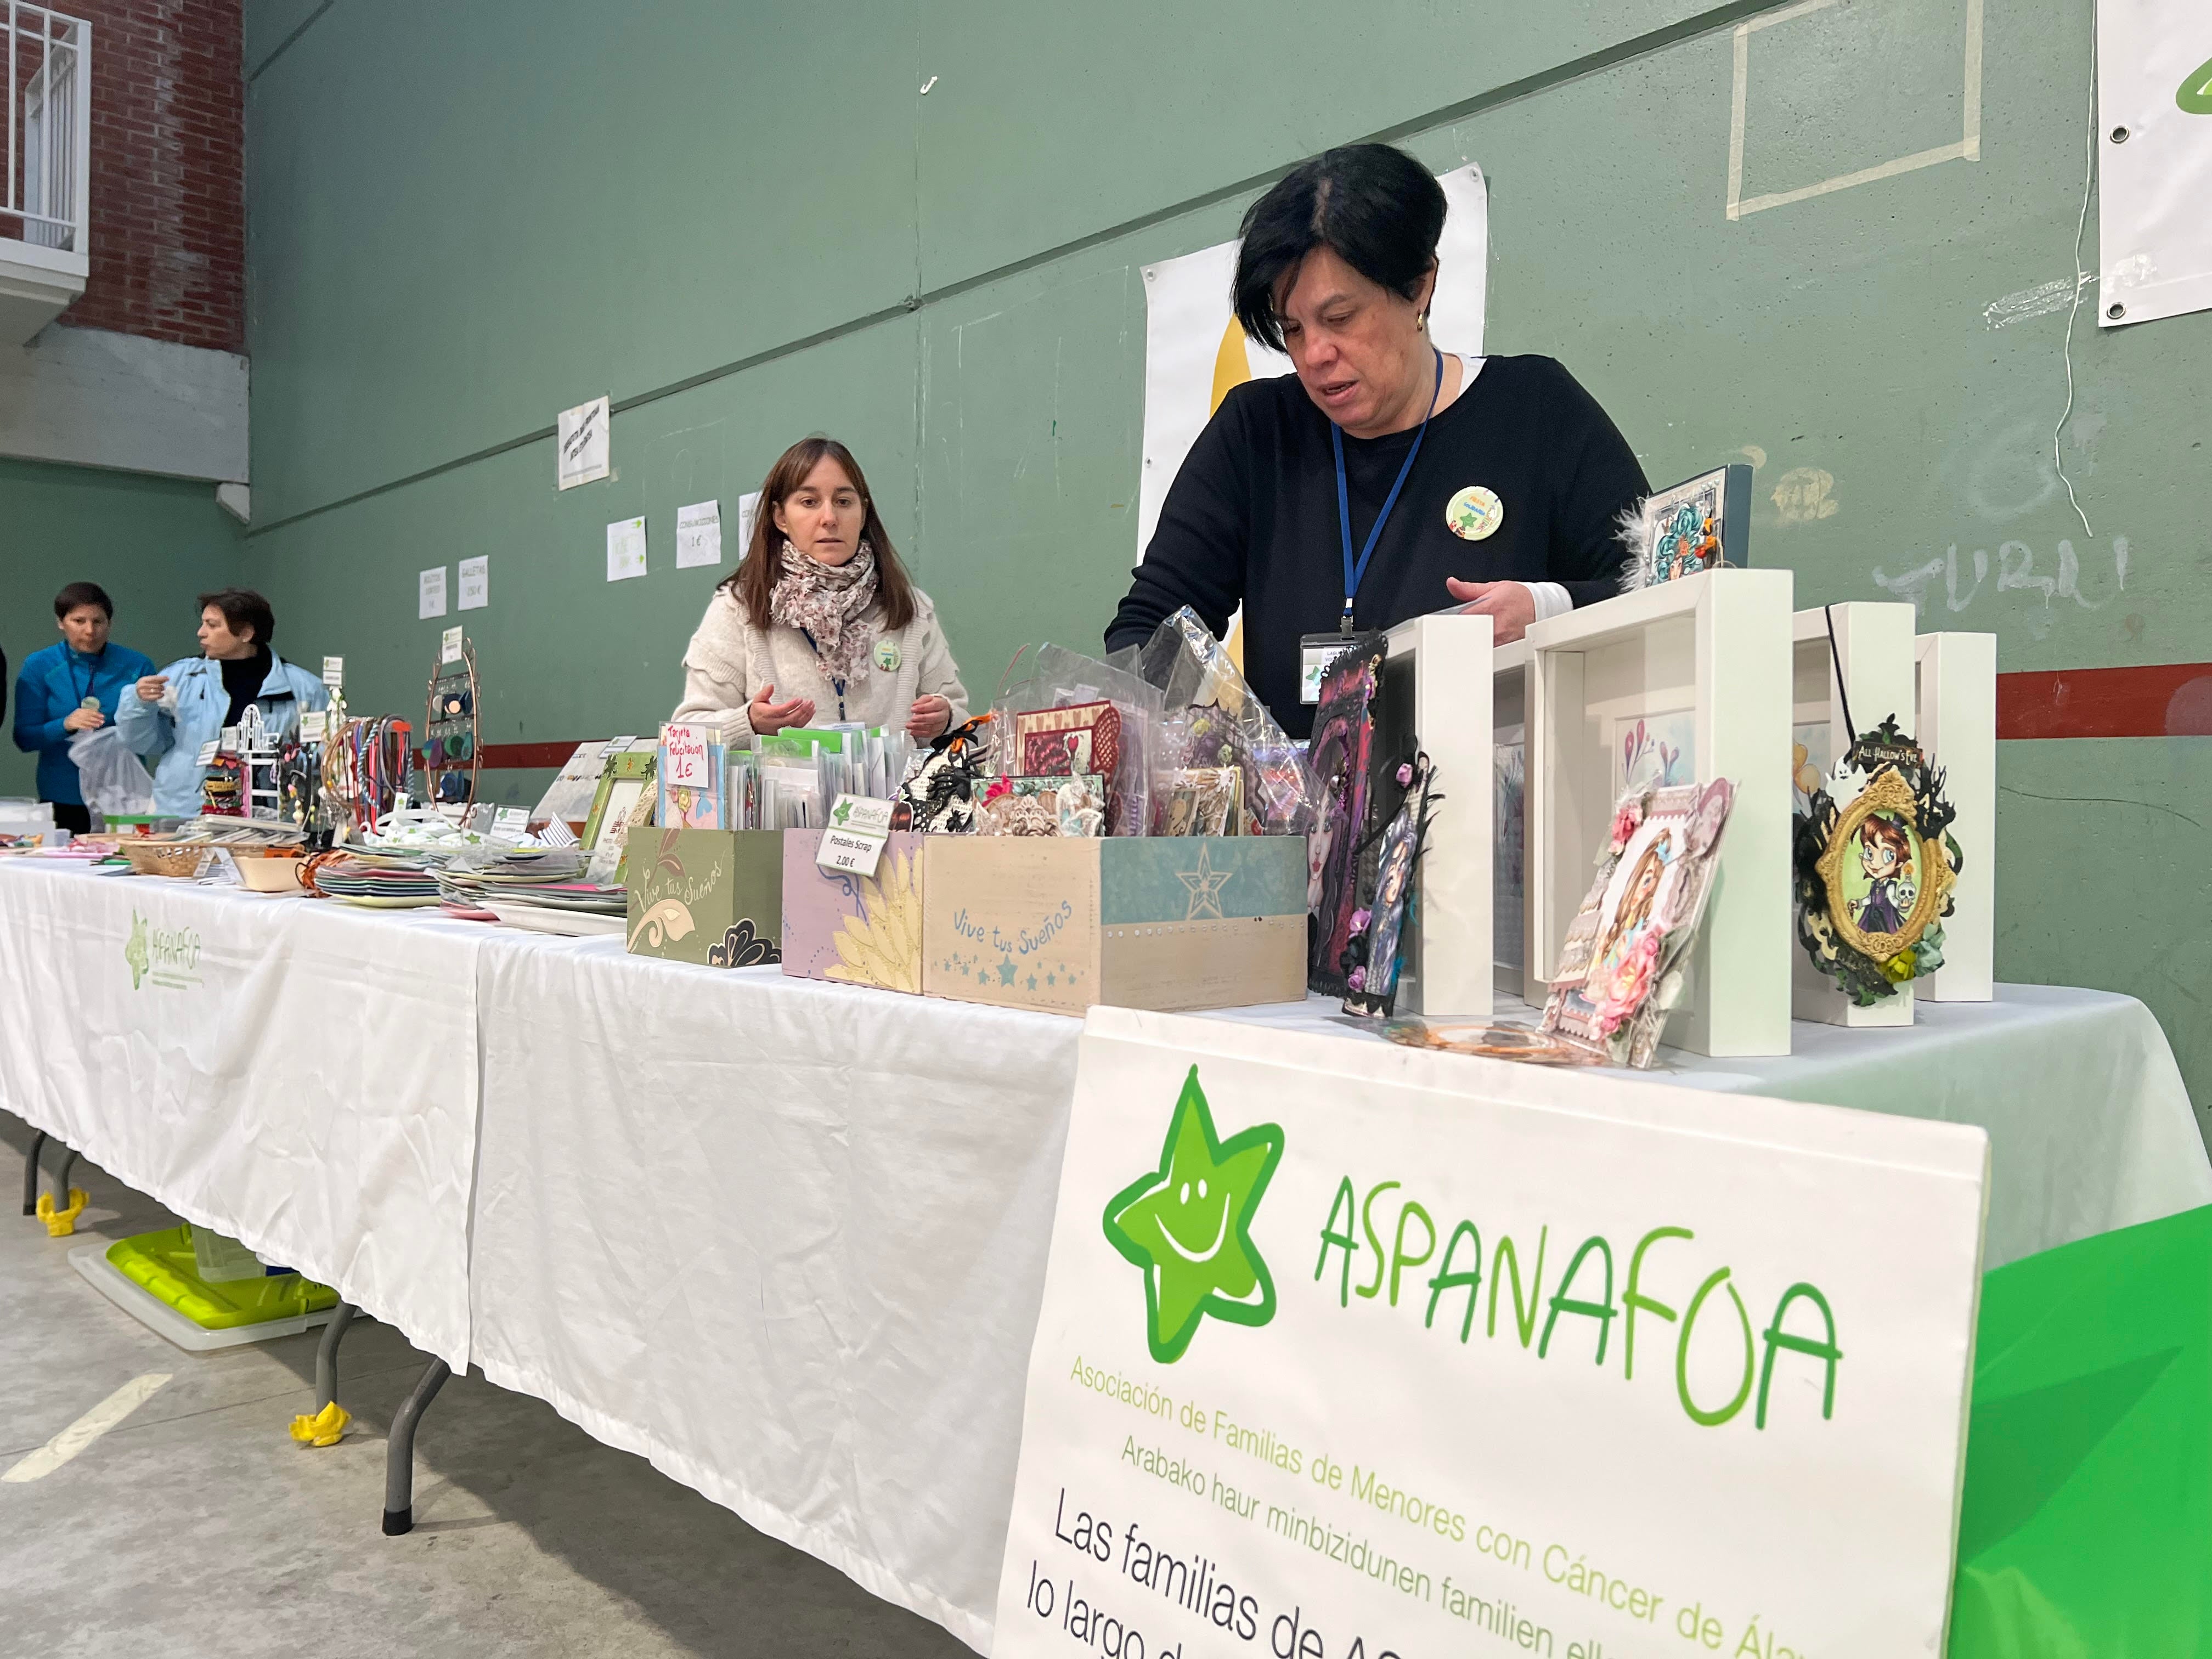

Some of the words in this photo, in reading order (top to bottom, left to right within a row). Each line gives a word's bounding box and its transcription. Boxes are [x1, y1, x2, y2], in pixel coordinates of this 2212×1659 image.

[668, 725, 690, 745] Tarjeta
[1858, 746, 1872, 760] ALL
[830, 835, 854, 848] Postales
[854, 840, 872, 853] Scrap
[635, 866, 663, 913] Vive
[665, 878, 683, 895] tus
[954, 908, 985, 943] Vive
[992, 926, 1012, 953] tus
[1019, 900, 1072, 955] Sueños
[1313, 1175, 1843, 1430] ASPANAFOA
[1070, 1355, 1172, 1420] Asociación
[1180, 1400, 1206, 1433] de
[1214, 1410, 1304, 1475] Familias
[1311, 1453, 1343, 1490] de
[1351, 1464, 1465, 1542] Menores
[1476, 1525, 1532, 1571] con
[1543, 1544, 1664, 1624] Cáncer
[1677, 1602, 1723, 1650] de
[1056, 1487, 1113, 1562] Las
[1122, 1523, 1259, 1641] familias
[1272, 1605, 1323, 1659] de
[1121, 1435, 1206, 1496] Arabako
[1211, 1473, 1260, 1521] haur
[1266, 1505, 1431, 1602] minbizidunen
[1441, 1576, 1553, 1658] familien
[1028, 1559, 1054, 1618] lo
[1063, 1579, 1144, 1659] largo
